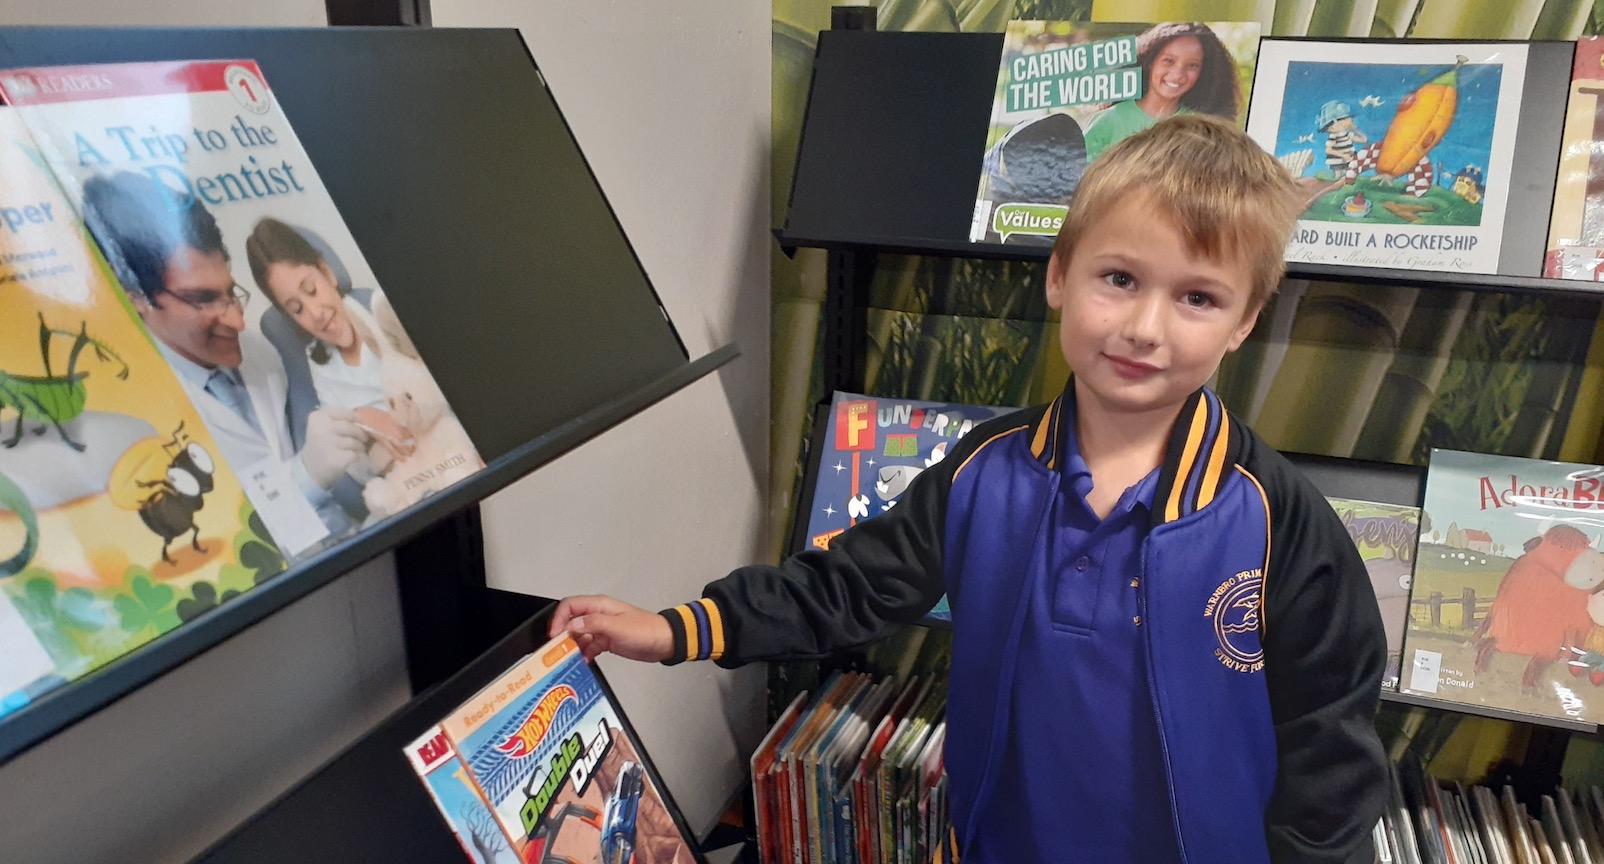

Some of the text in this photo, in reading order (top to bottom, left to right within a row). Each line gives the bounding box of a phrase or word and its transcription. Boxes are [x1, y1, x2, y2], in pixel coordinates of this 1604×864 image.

[1013, 39, 1133, 82] CARING FOR
[238, 78, 258, 103] 1
[1010, 70, 1138, 111] THE WORLD
[74, 115, 278, 167] A Trip to the
[143, 155, 305, 213] Dentist
[1000, 210, 1063, 230] Values
[1325, 230, 1361, 247] BUILT
[1366, 233, 1377, 248] A
[1383, 232, 1479, 251] ROCKETSHIP
[403, 452, 467, 490] PENNY SMITH
[1477, 473, 1604, 511] AdoraB
[1214, 647, 1250, 673] STRIVE
[463, 670, 533, 728] Ready-to-Read
[1446, 677, 1475, 688] Donald
[569, 719, 612, 796] Duel
[519, 733, 582, 836] Double
